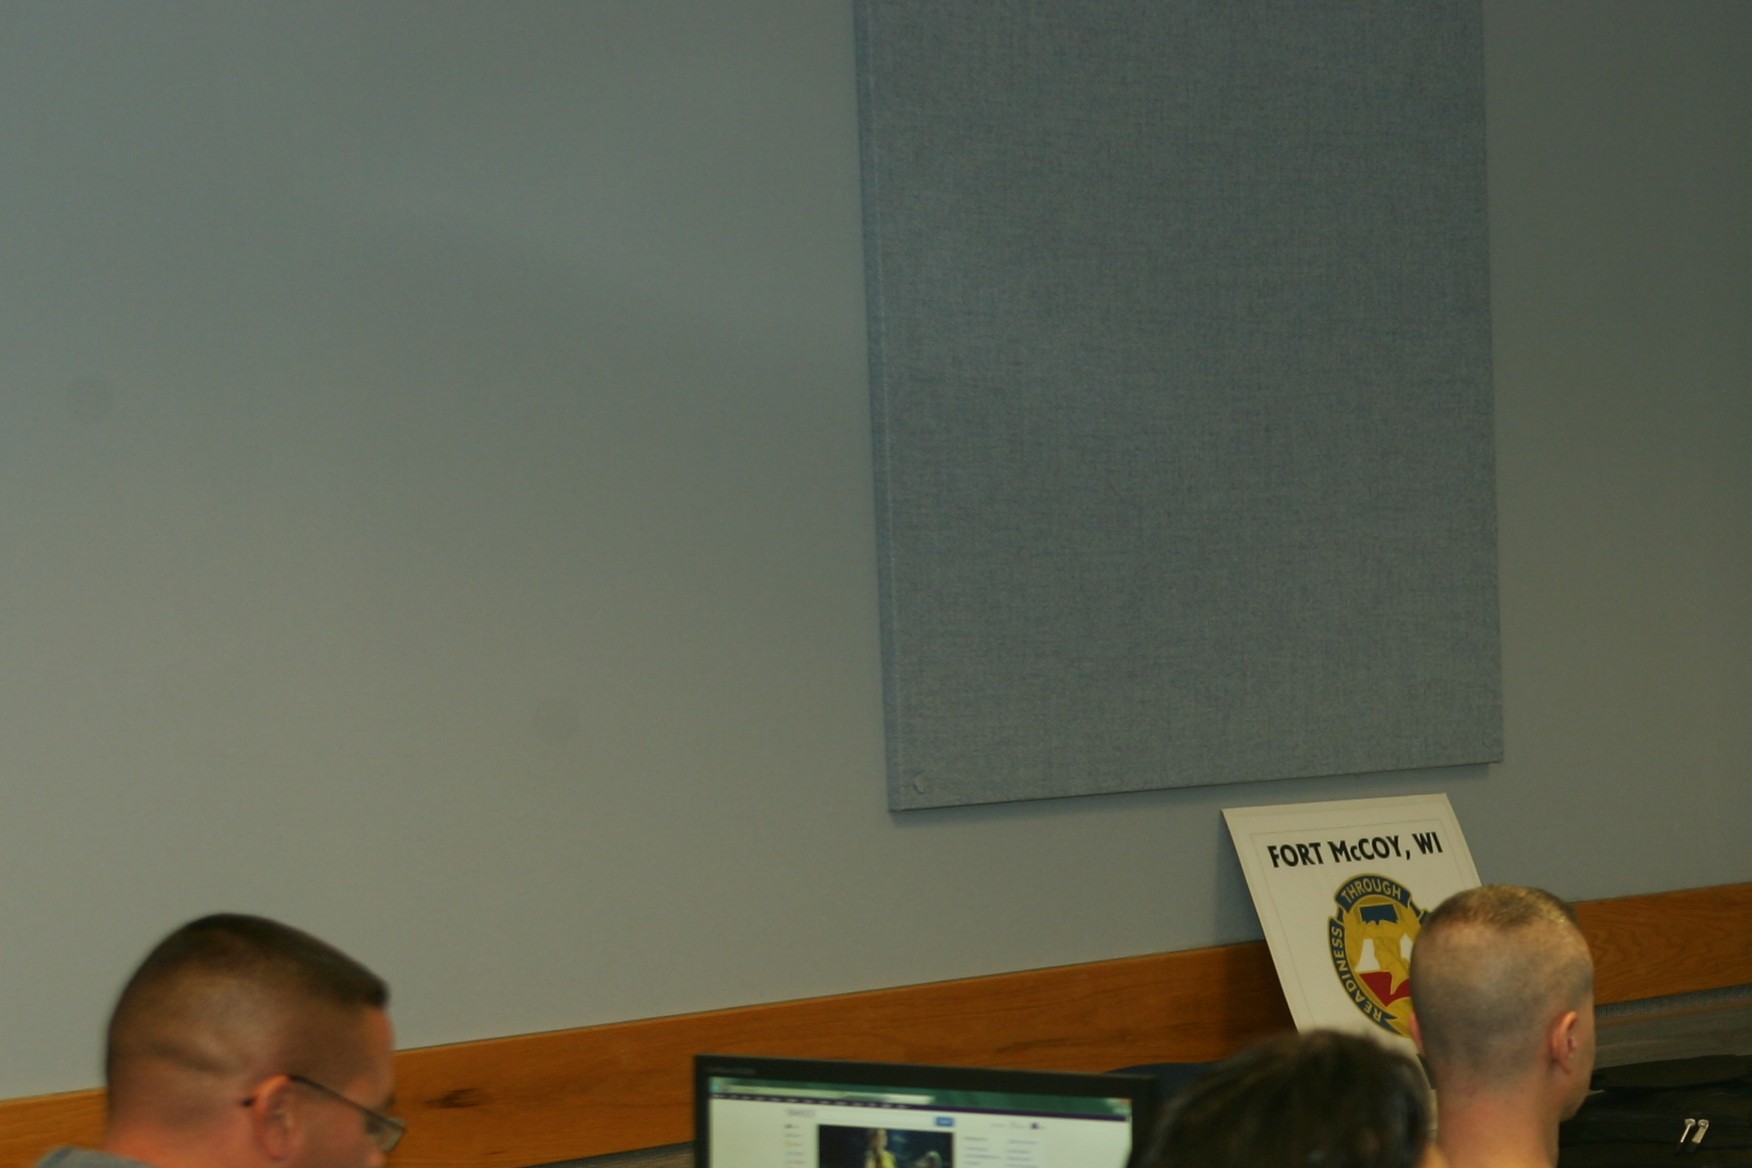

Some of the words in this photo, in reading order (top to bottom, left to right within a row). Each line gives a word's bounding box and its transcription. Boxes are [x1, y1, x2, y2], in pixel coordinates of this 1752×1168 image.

[1267, 842, 1324, 868] FORT
[1328, 835, 1411, 863] McCOY,
[1412, 831, 1444, 854] WI
[1341, 877, 1402, 905] THROUGH
[1331, 926, 1382, 1021] READINESS
